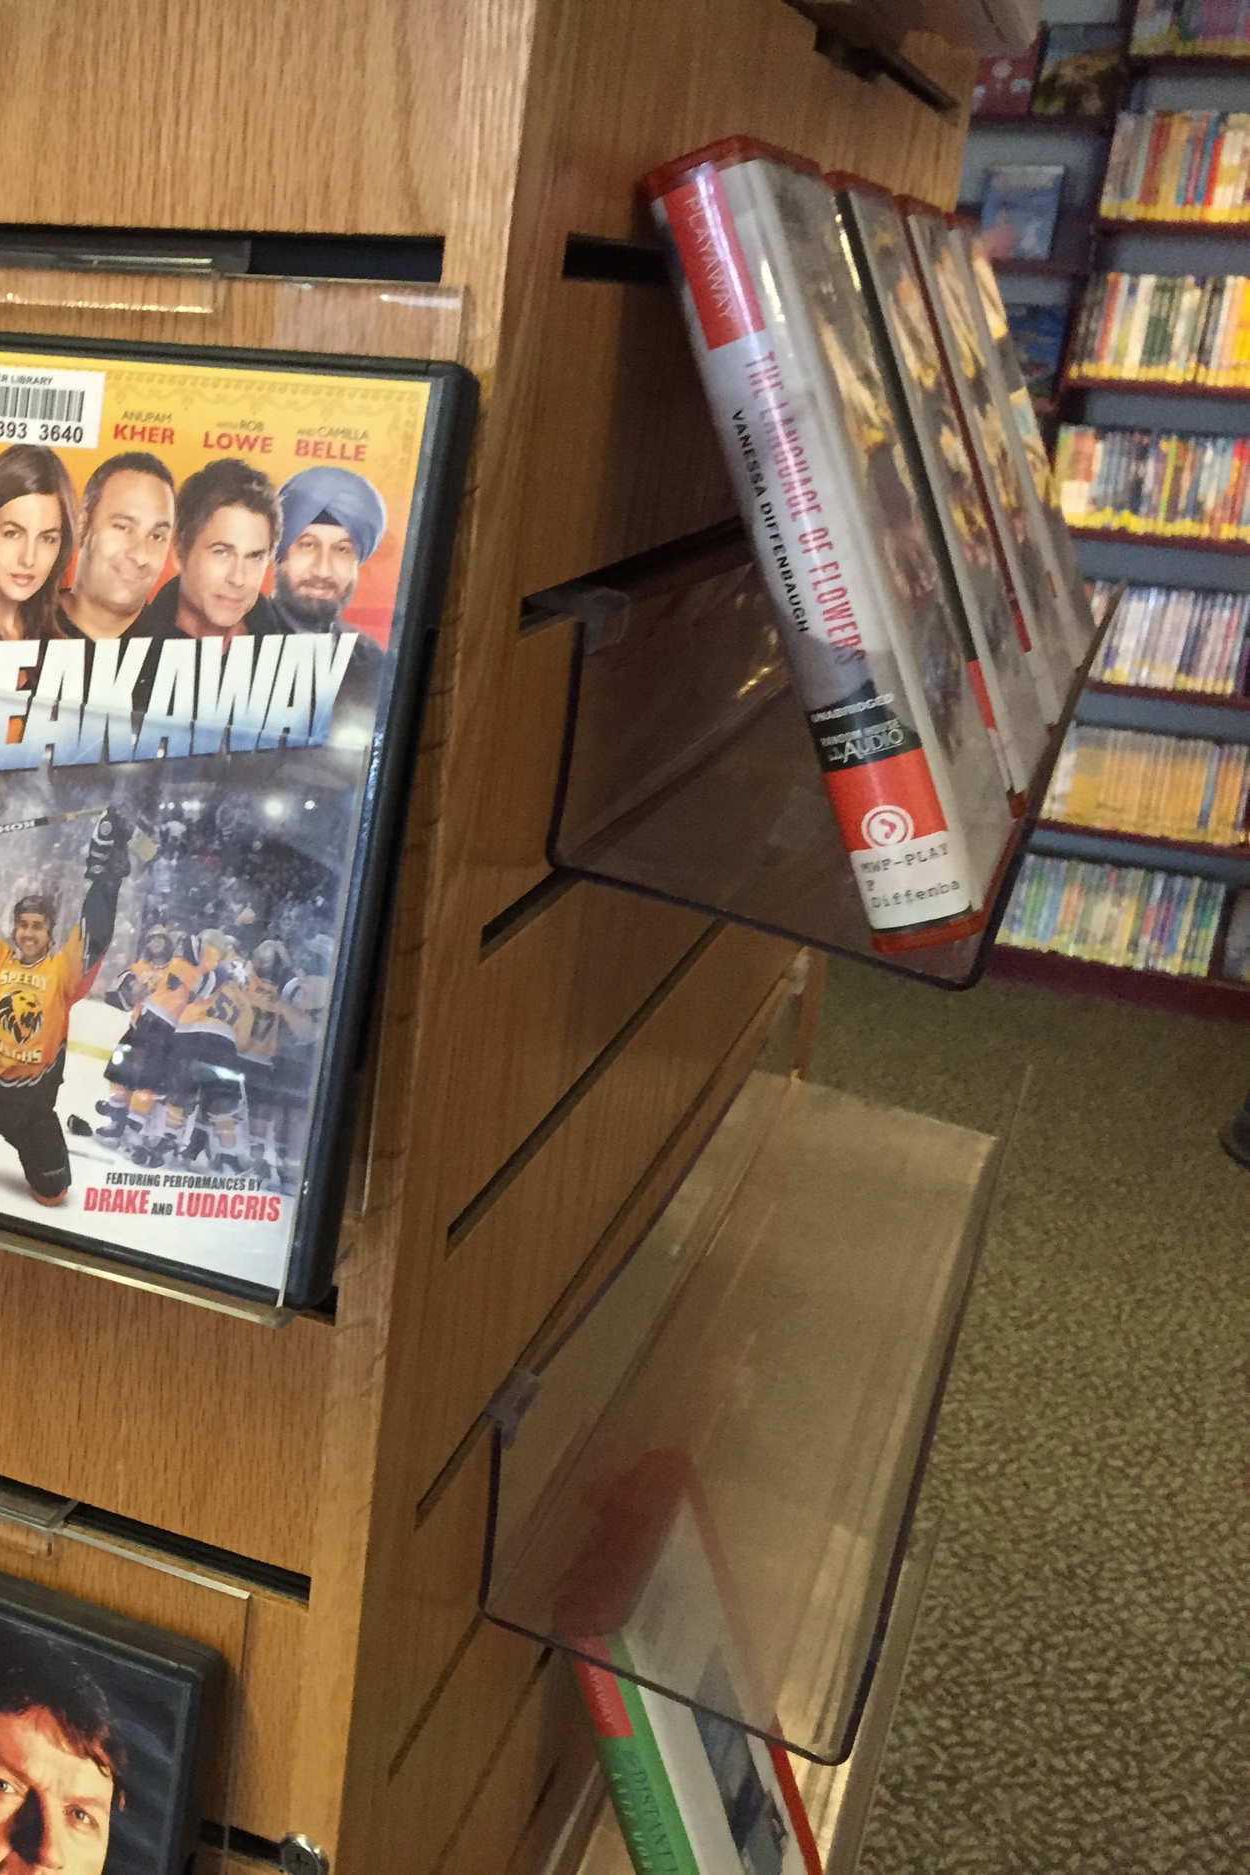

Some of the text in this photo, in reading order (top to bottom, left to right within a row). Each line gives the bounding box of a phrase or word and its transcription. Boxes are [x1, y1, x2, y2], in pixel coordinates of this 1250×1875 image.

[10, 374, 54, 386] LIBRARY
[744, 351, 785, 398] THE
[121, 410, 172, 423] ANUPAM
[238, 420, 266, 432] ROB
[38, 423, 84, 444] 3640
[113, 423, 175, 445] KHER
[202, 431, 274, 454] LOWE
[317, 425, 369, 441] CAMILLA
[295, 439, 368, 462] BELLE
[759, 401, 823, 522] LANGUAGE
[731, 408, 810, 634] VANESSA DIFFENBAUGH
[798, 526, 834, 554] OF
[807, 561, 867, 667] FLOWERS
[843, 728, 904, 764] AUDIO
[106, 1172, 263, 1192] FEATURING PERFORMANCES BY
[84, 1187, 282, 1222] DRAKE AND LUDACRIS
